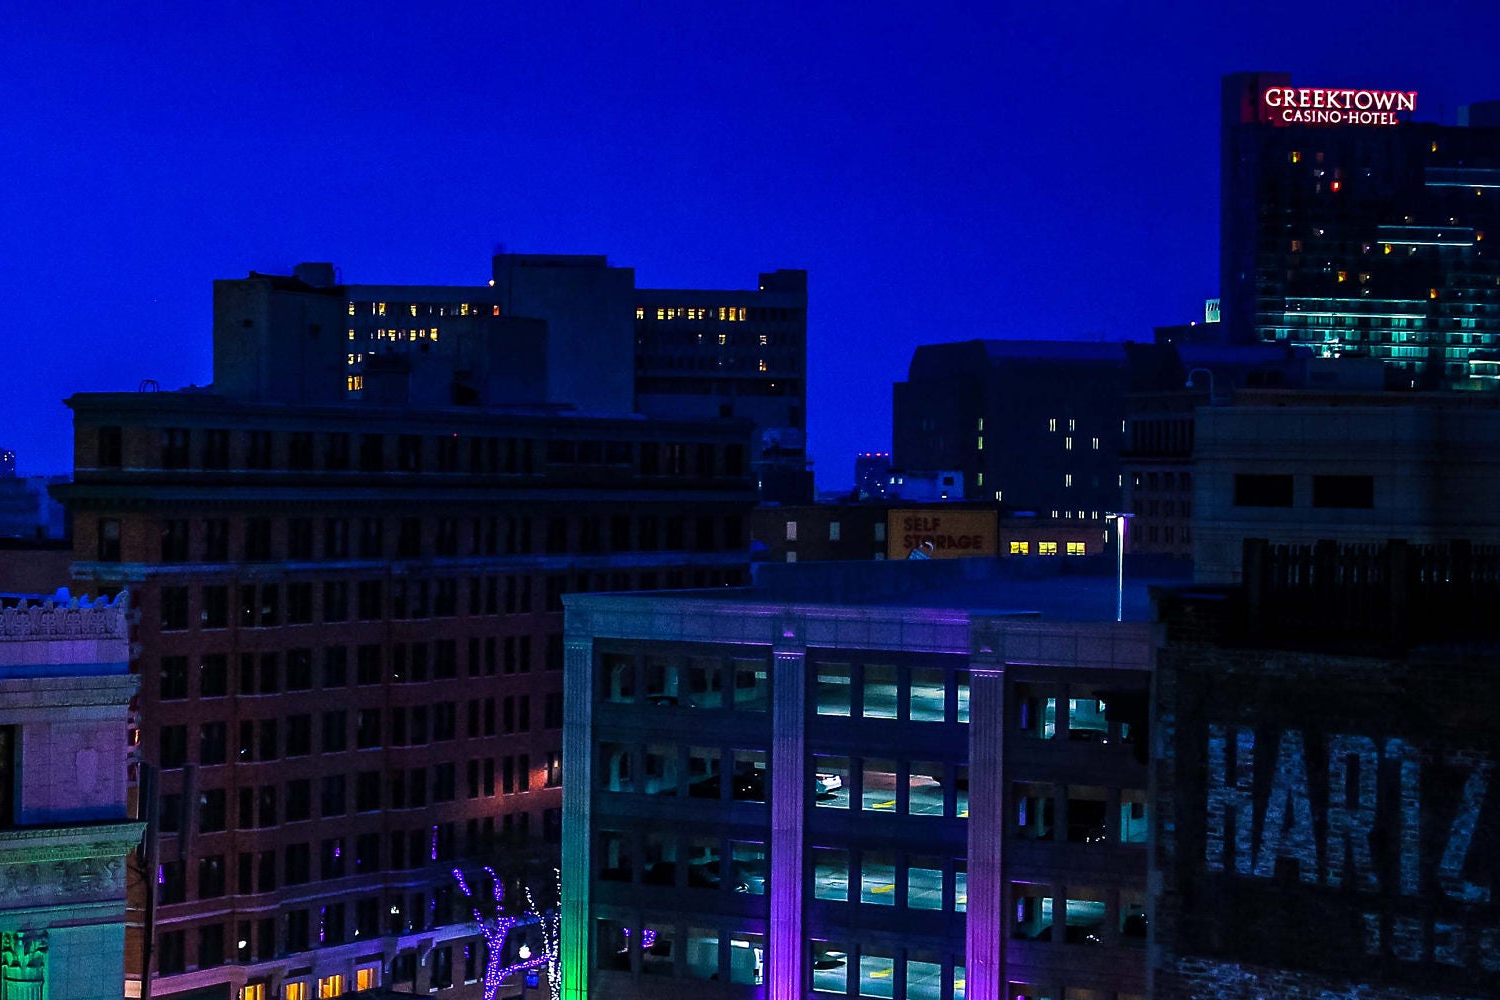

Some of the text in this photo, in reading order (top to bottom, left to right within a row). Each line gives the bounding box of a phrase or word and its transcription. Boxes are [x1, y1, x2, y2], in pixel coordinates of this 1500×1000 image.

[1264, 87, 1417, 112] GREEKTOWN
[1282, 109, 1398, 126] CASINO-HOTEL
[903, 517, 941, 532] SELF
[903, 534, 983, 550] STORAGE
[1204, 721, 1496, 904] HARTZ
